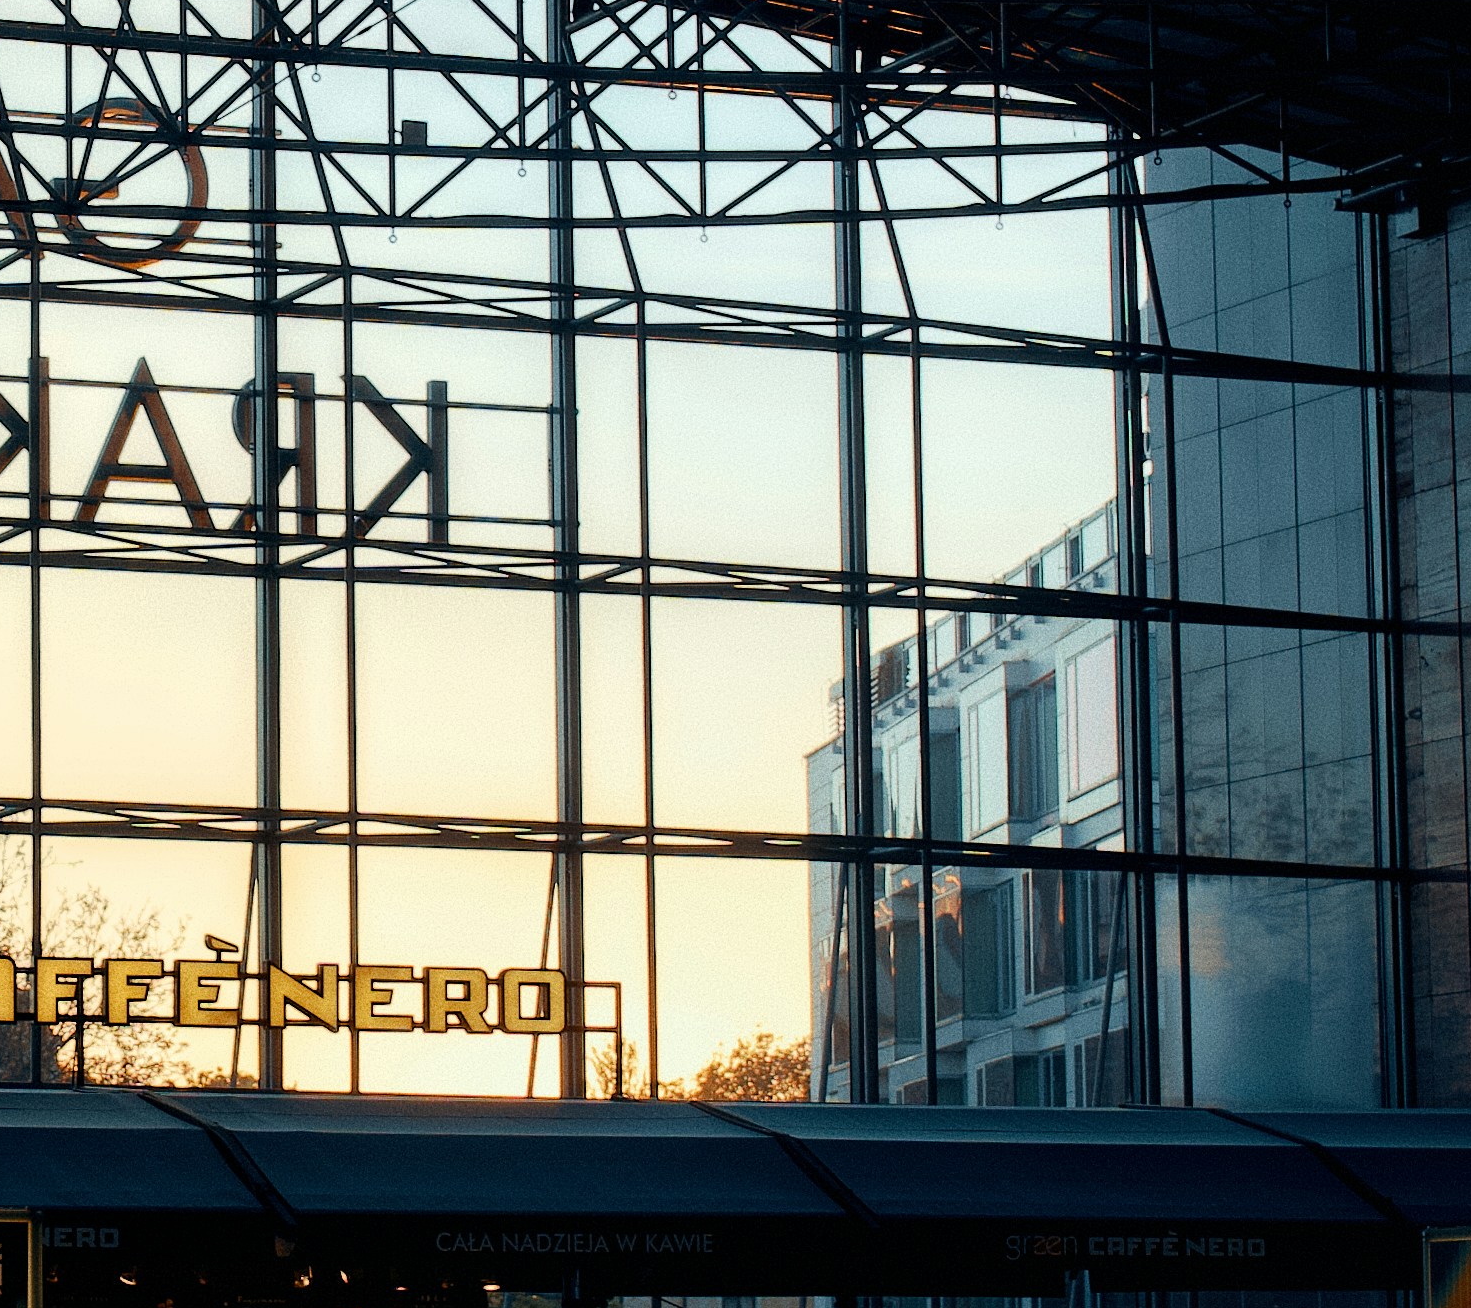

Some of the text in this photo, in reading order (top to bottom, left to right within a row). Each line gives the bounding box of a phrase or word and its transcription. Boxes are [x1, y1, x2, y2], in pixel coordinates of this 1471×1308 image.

[268, 962, 568, 1034] NERO
[435, 1231, 714, 1254] CAŁA NADZIEJA W KAWIE
[1006, 1229, 1266, 1261] green CAFFÈ NERO
